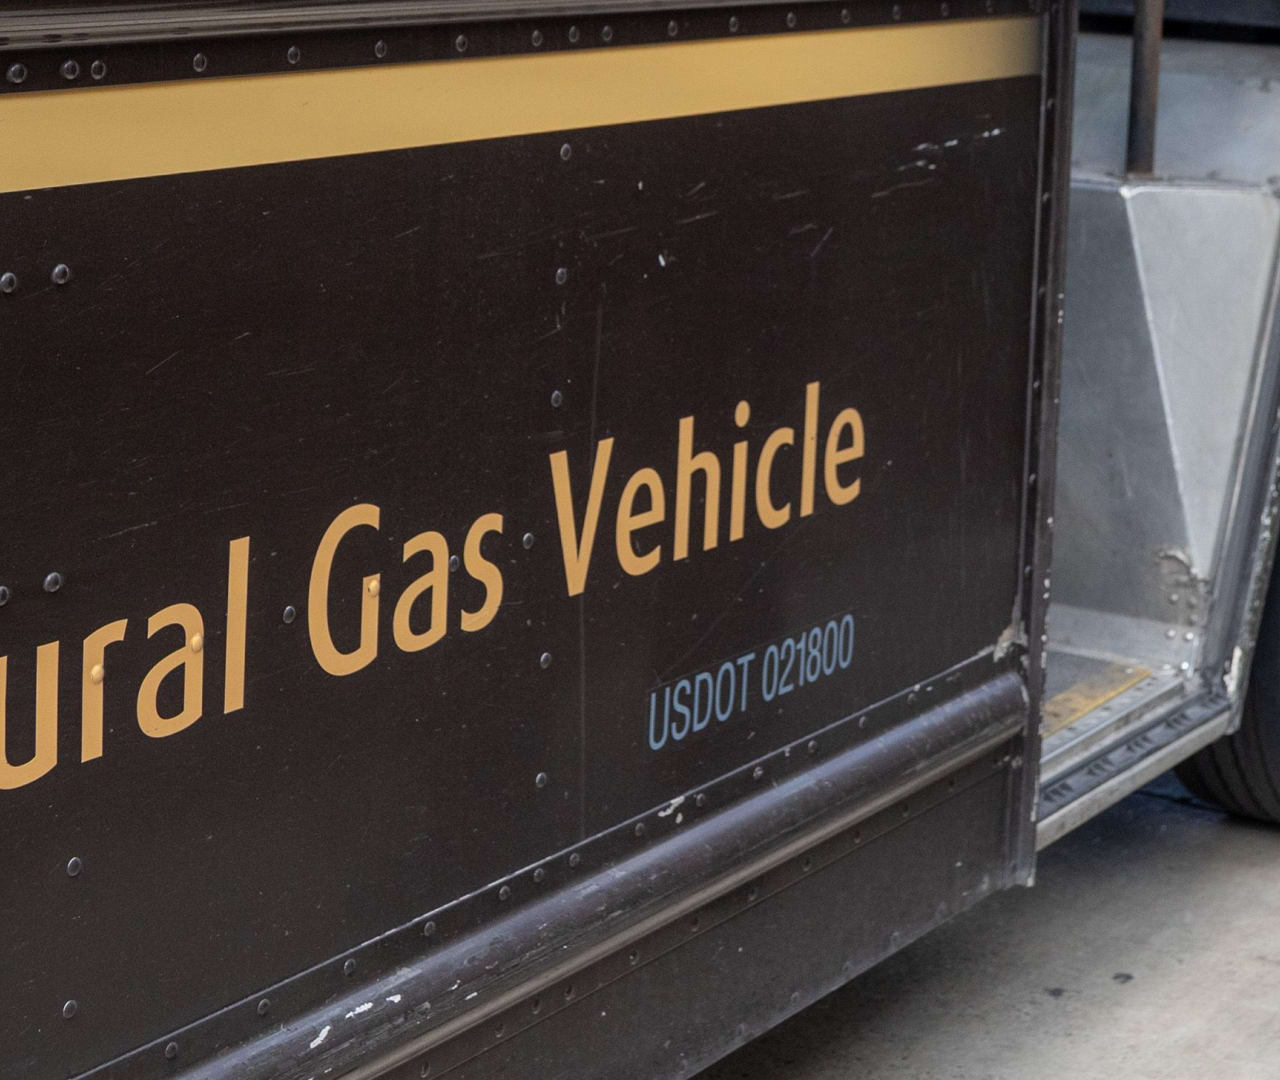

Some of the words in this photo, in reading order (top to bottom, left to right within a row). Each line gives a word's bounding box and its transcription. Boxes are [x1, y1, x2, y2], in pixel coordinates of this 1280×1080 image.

[307, 503, 504, 677] Gas
[549, 381, 865, 597] Vehicle
[648, 652, 756, 751] USDOT
[761, 614, 855, 702] 021800
